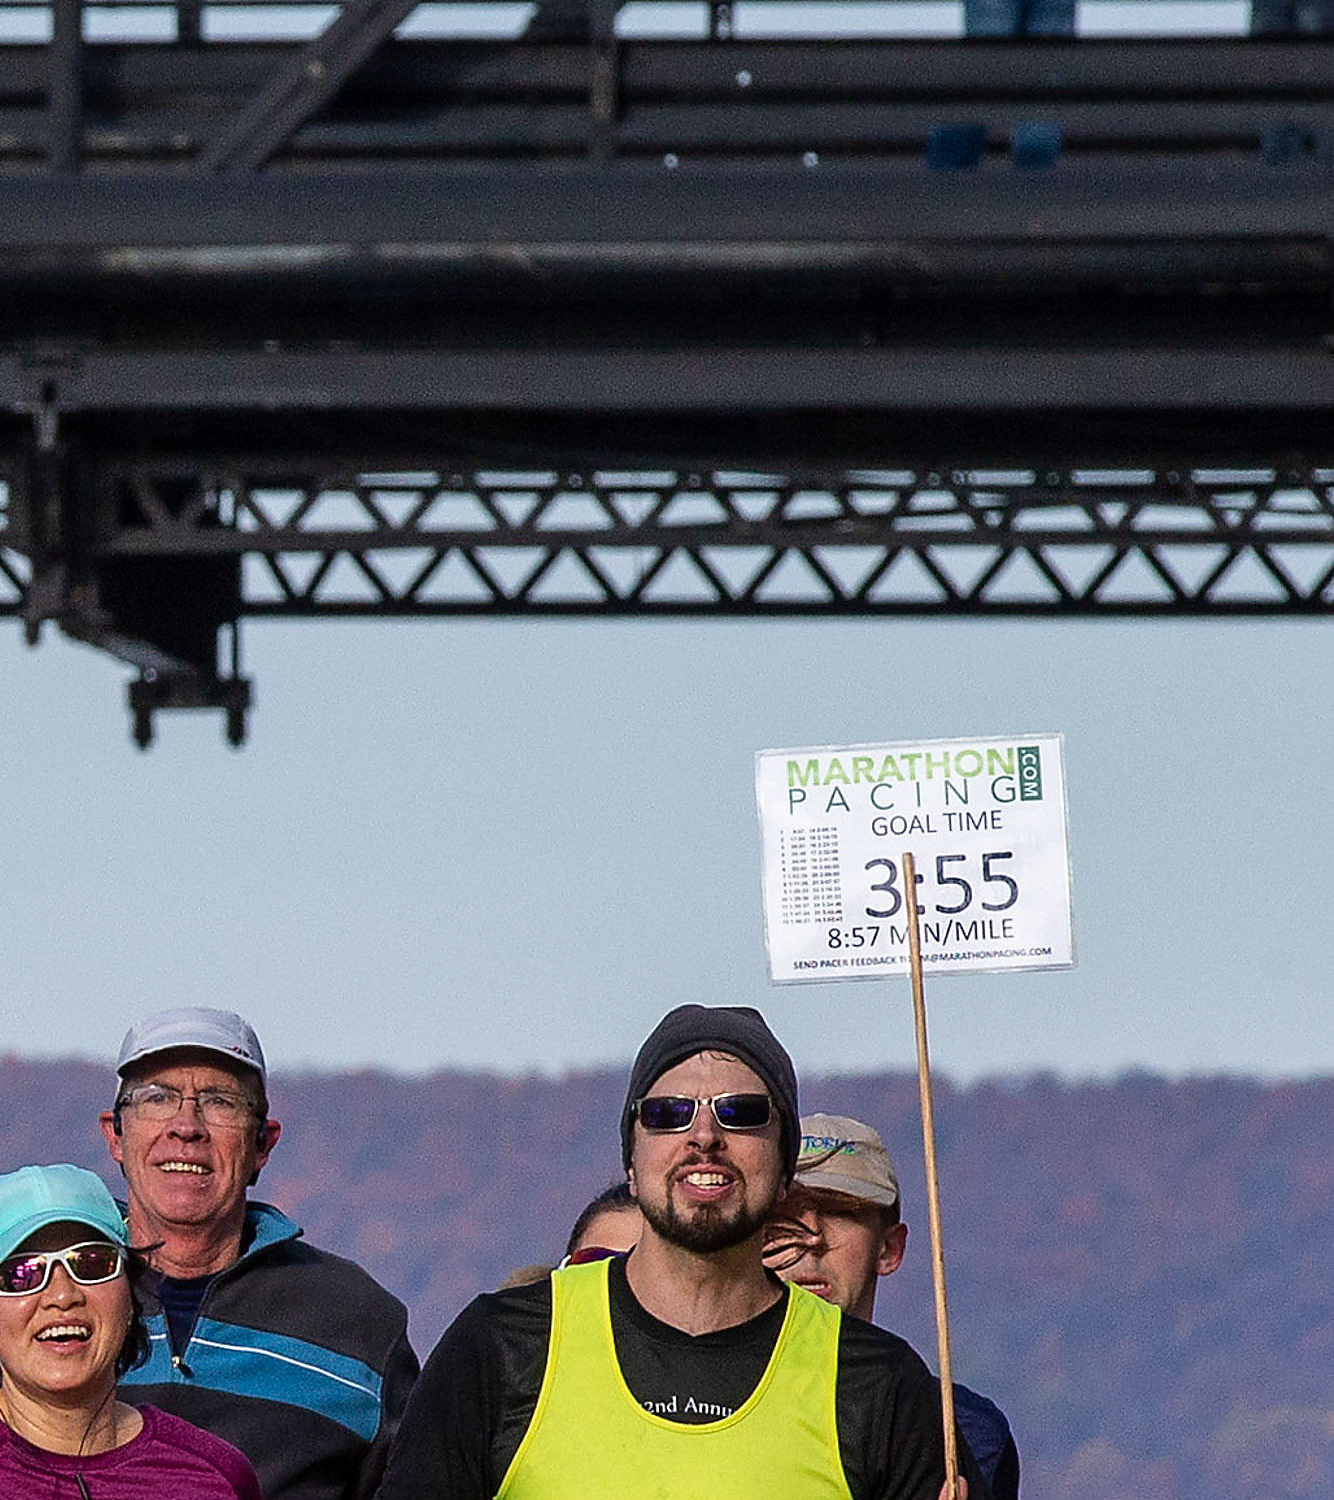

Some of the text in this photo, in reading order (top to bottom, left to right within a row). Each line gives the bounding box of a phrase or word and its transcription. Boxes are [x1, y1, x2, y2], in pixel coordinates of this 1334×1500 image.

[787, 747, 1014, 787] MARATHON
[788, 776, 1017, 815] PACING
[871, 809, 1003, 836] GOAL TIME
[864, 851, 1019, 918] 3:55
[827, 918, 1015, 949] 8:57 MN/MILE
[793, 959, 818, 969] SEND
[851, 955, 897, 966] FEEDBACK
[685, 1396, 733, 1417] Annu
